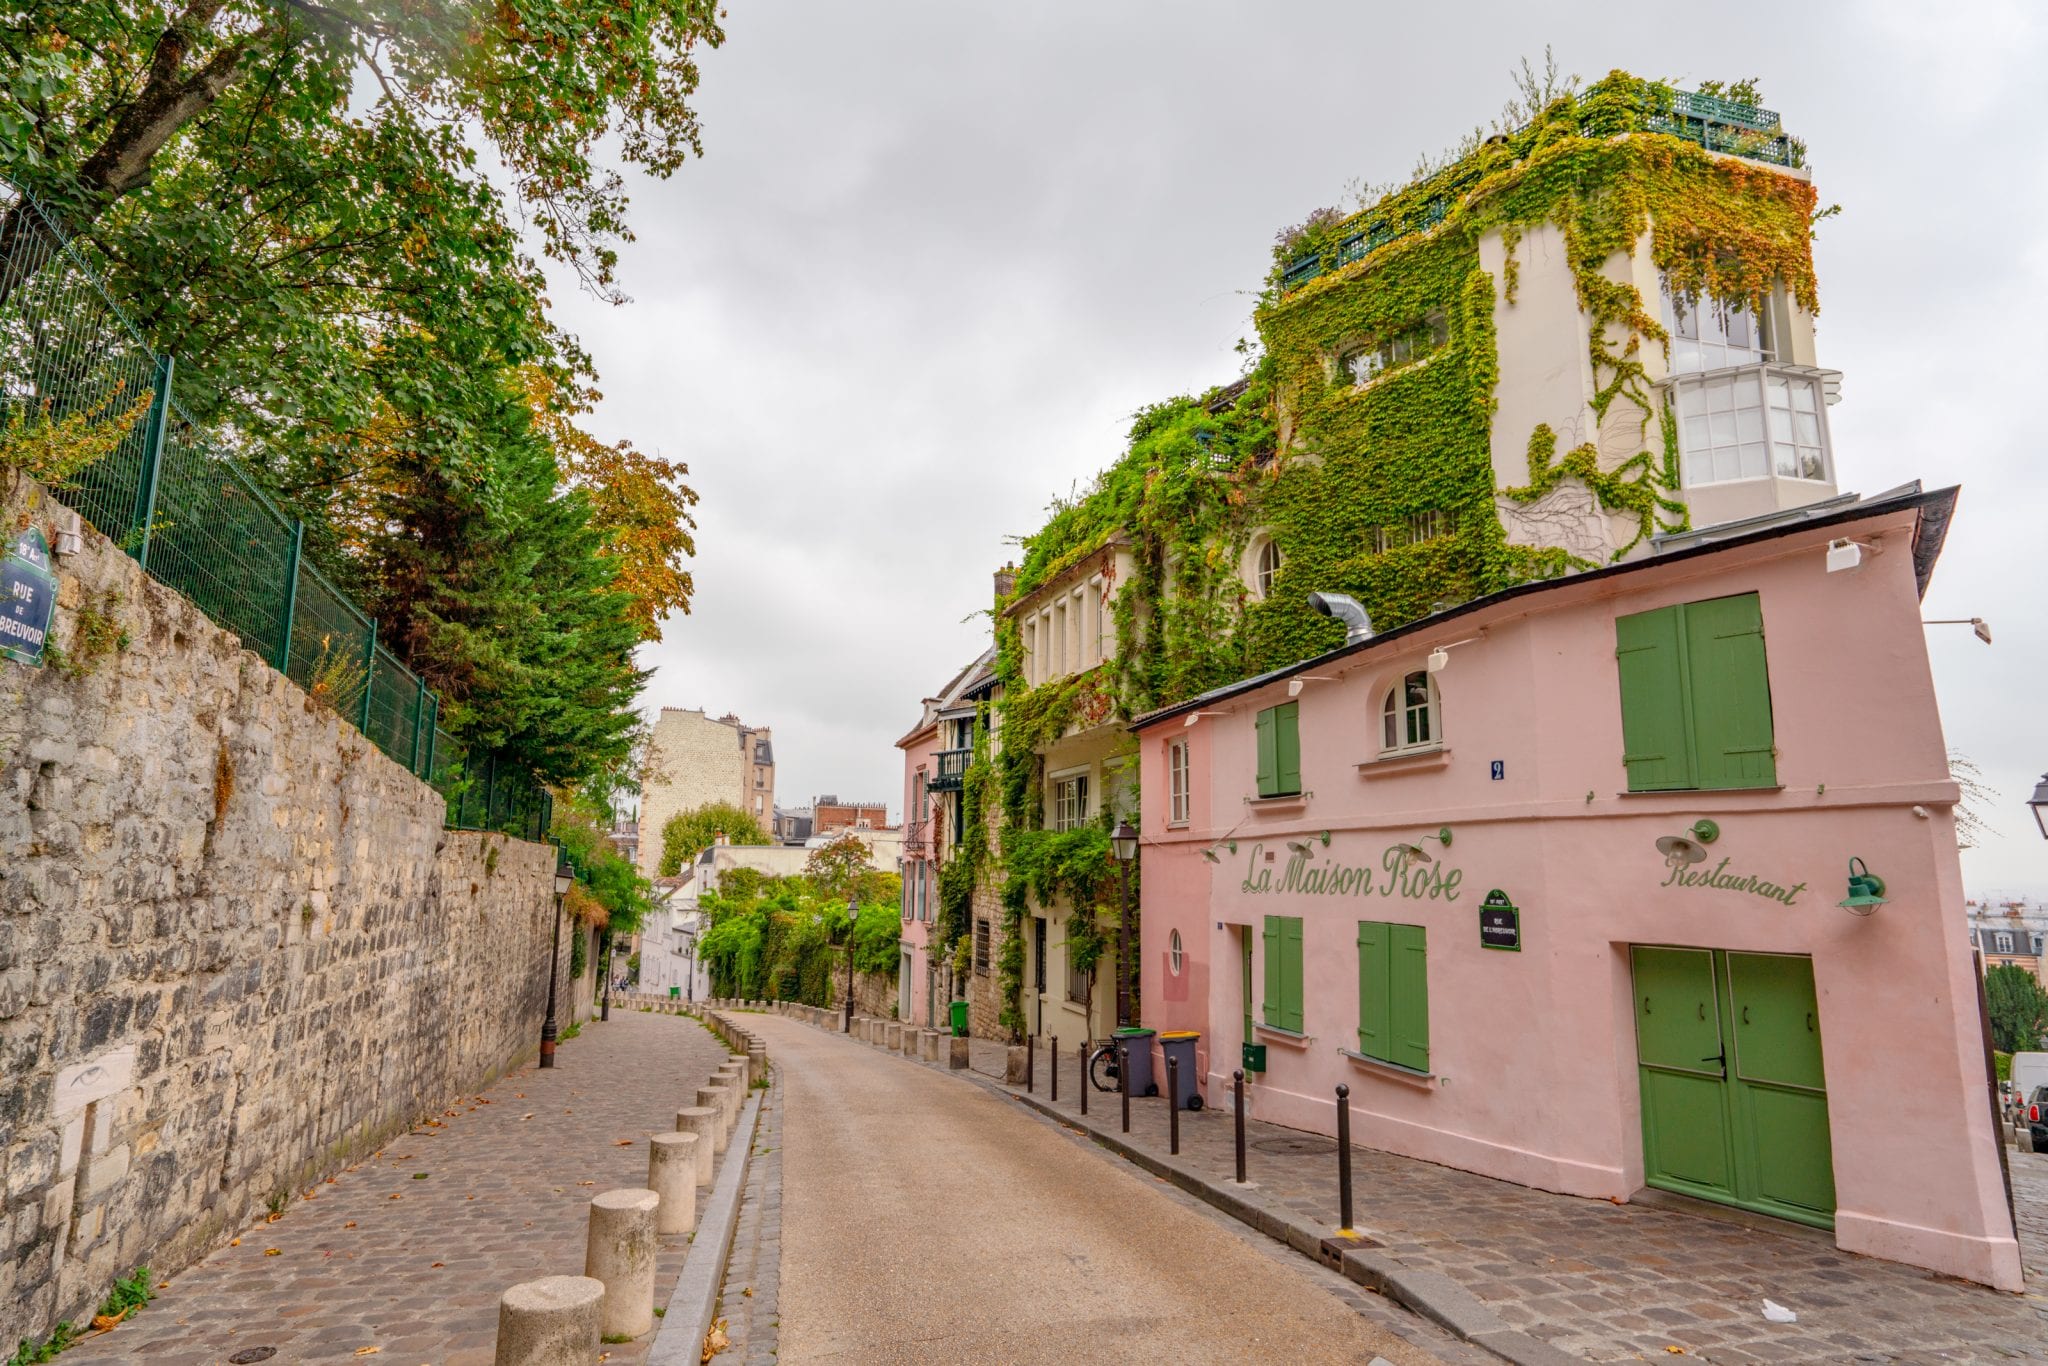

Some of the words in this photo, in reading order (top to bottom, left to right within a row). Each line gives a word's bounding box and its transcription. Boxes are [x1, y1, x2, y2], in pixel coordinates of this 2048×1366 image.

[13, 580, 34, 603] RUE
[15, 605, 24, 616] DE
[1493, 761, 1502, 780] 2
[1241, 843, 1272, 894] La
[1275, 840, 1374, 897] Maison
[1379, 844, 1463, 902] Rose
[1660, 856, 1808, 906] Restaurant
